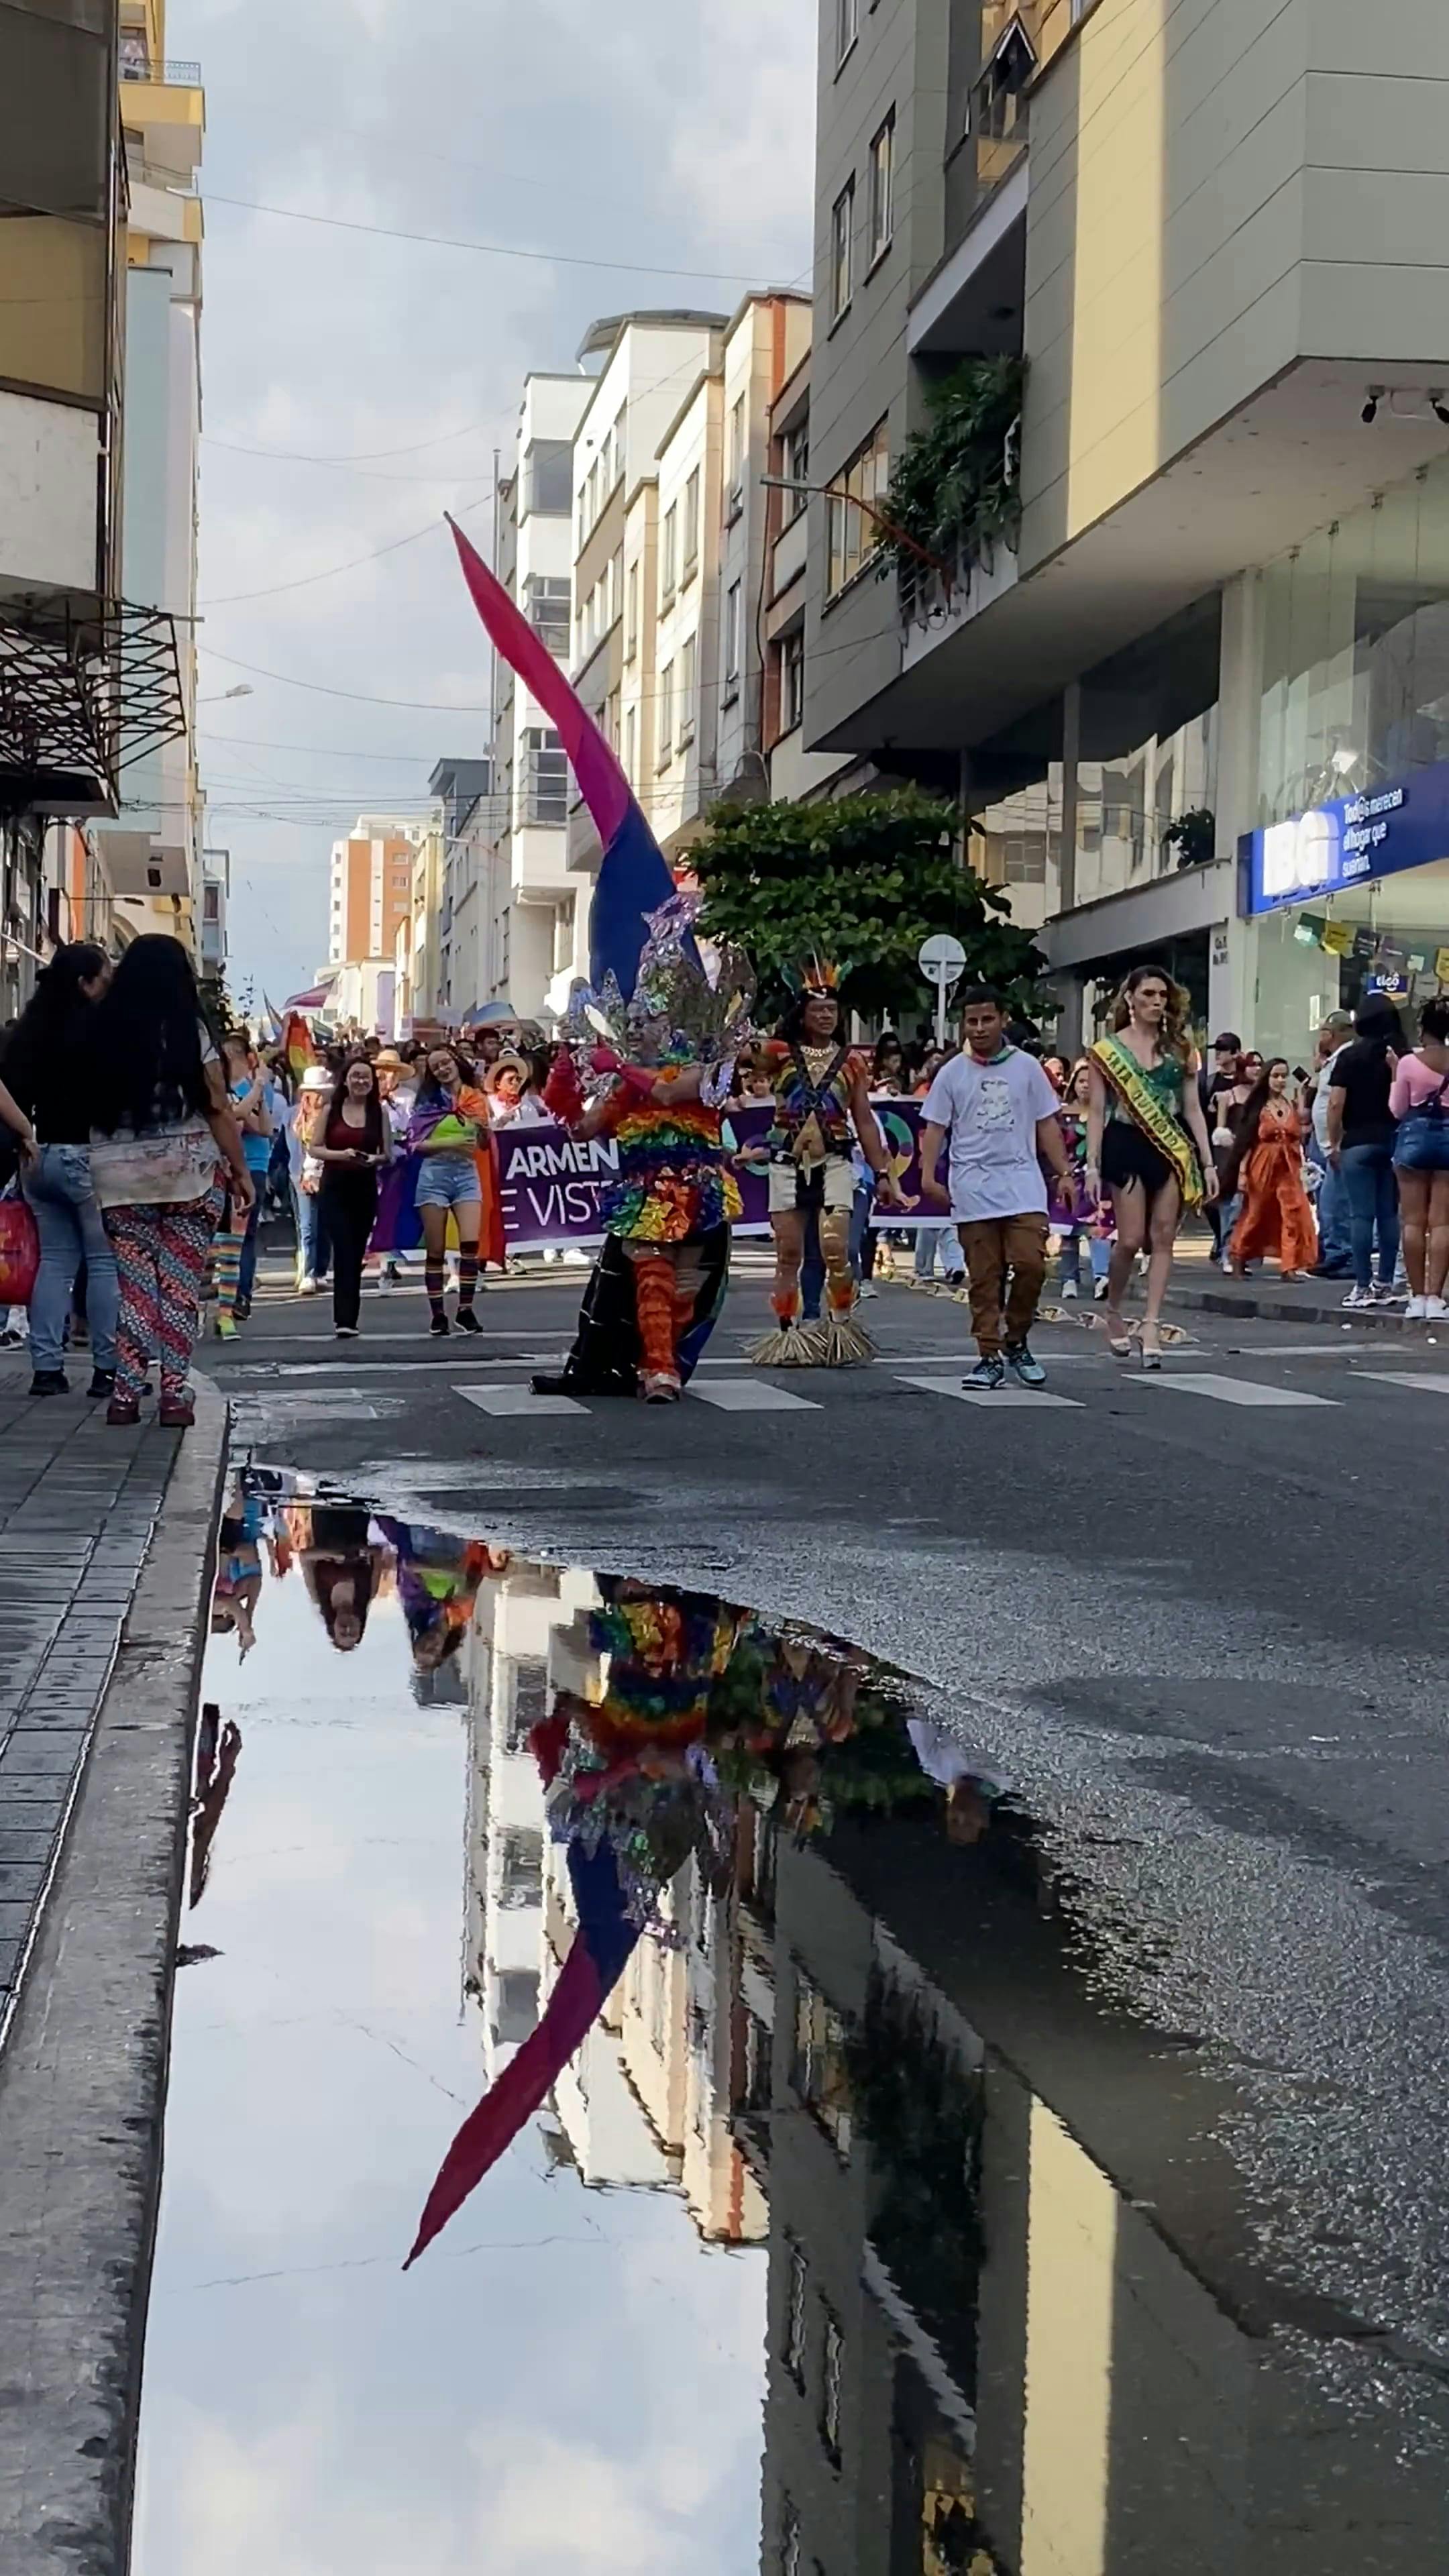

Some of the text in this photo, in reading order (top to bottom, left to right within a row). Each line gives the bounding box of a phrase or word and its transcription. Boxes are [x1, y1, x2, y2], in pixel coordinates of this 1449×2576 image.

[1350, 826, 1371, 852] hogar
[1371, 821, 1387, 847] que
[527, 1180, 614, 1226] VIST
